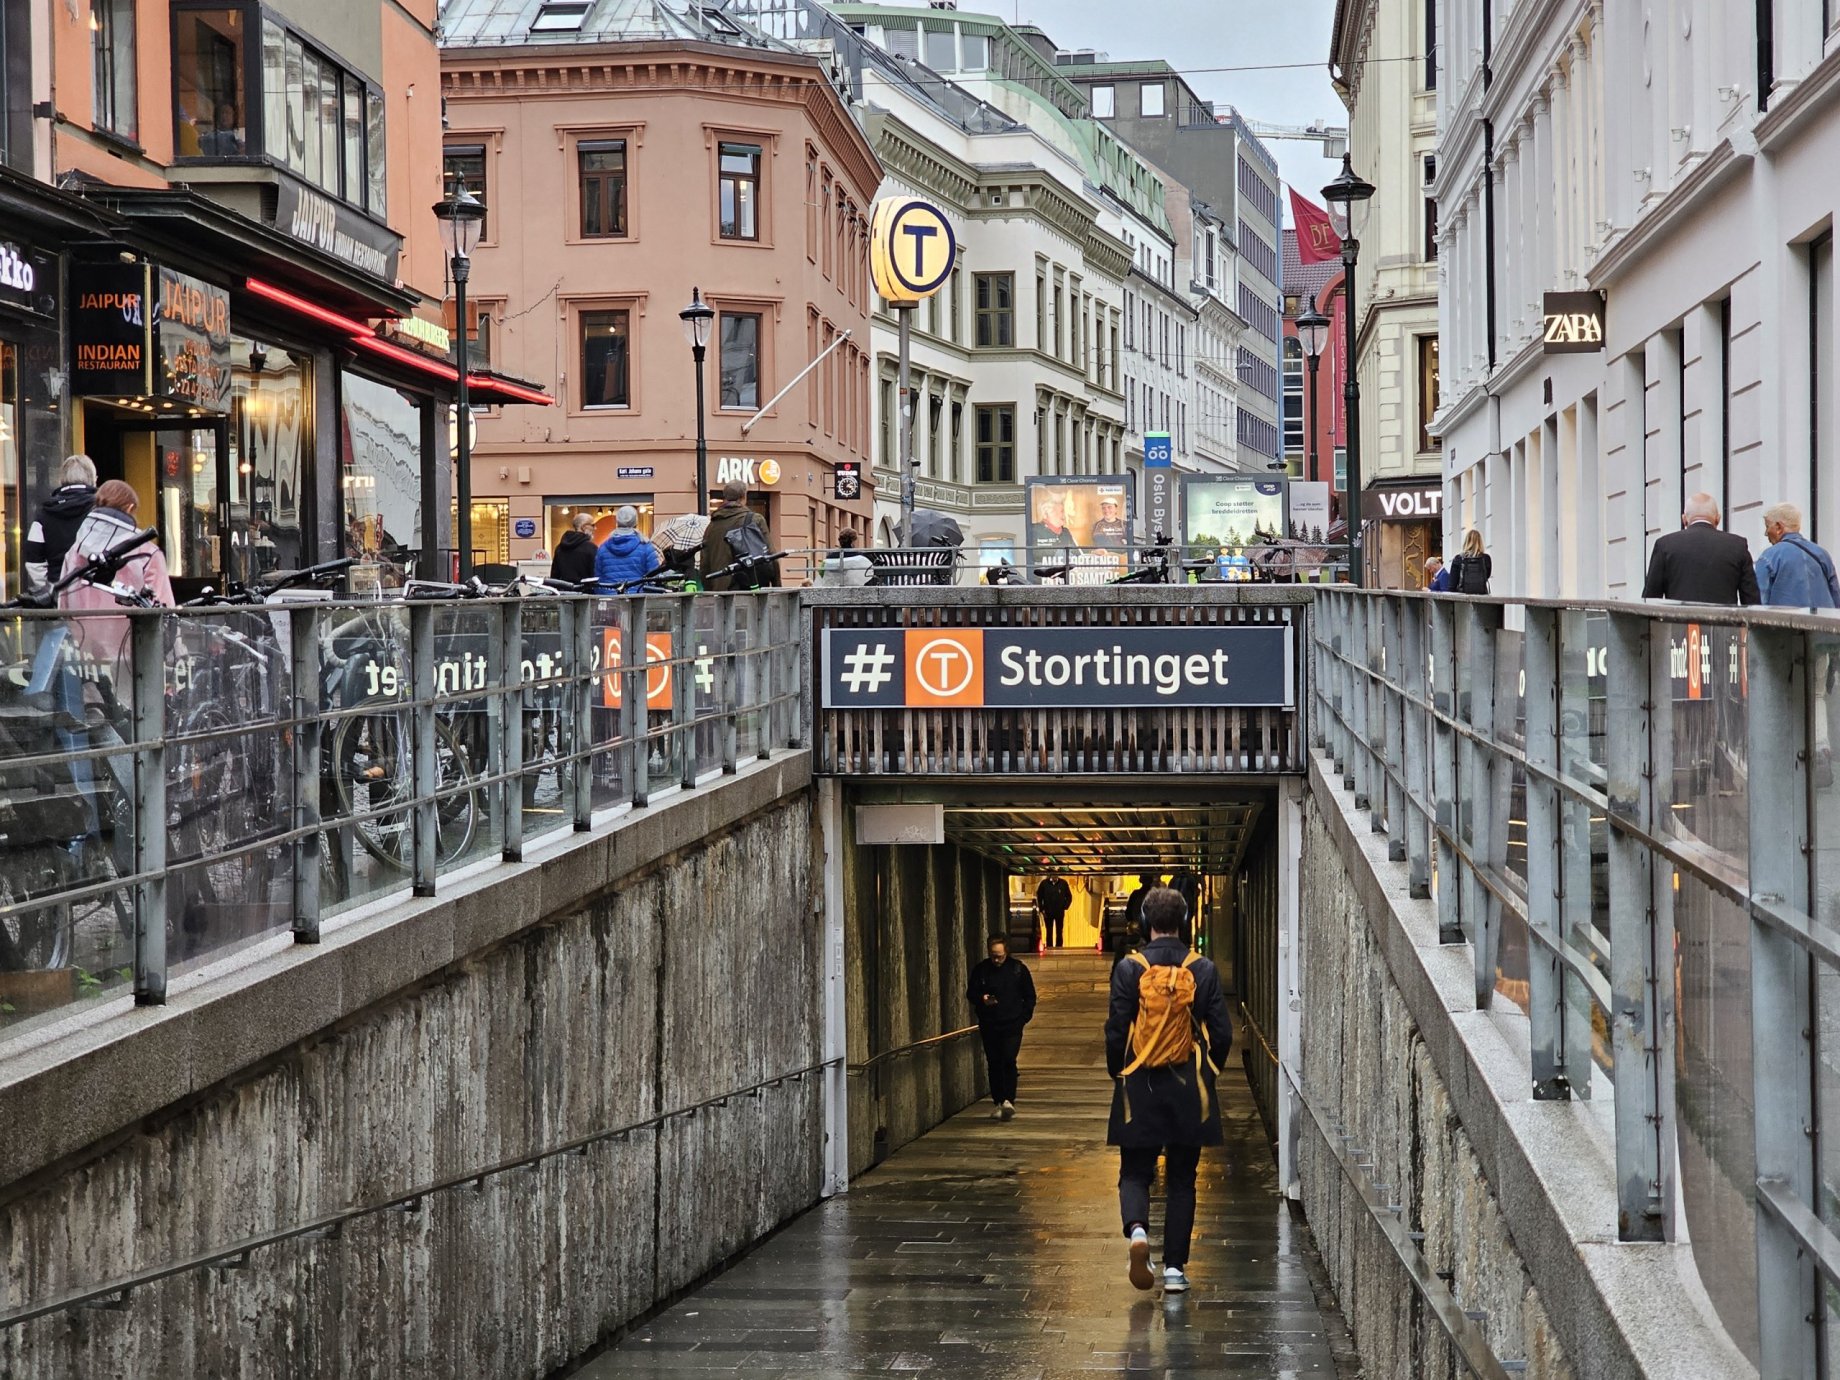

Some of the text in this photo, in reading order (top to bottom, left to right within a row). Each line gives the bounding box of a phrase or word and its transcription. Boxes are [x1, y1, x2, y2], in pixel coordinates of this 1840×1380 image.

[292, 187, 336, 253] JAIPUR
[903, 224, 938, 277] T
[0, 247, 34, 292] kko
[80, 293, 138, 309] JAIPUR
[164, 280, 226, 337] JAIPUR
[1543, 312, 1602, 343] ZARA
[78, 344, 141, 360] INDIAN
[78, 360, 141, 370] RESTAURANT
[717, 457, 756, 484] ARK
[1153, 474, 1165, 504] Oslo
[1379, 490, 1442, 516] VOLT
[929, 652, 959, 689] T
[999, 645, 1229, 695] Stortinget
